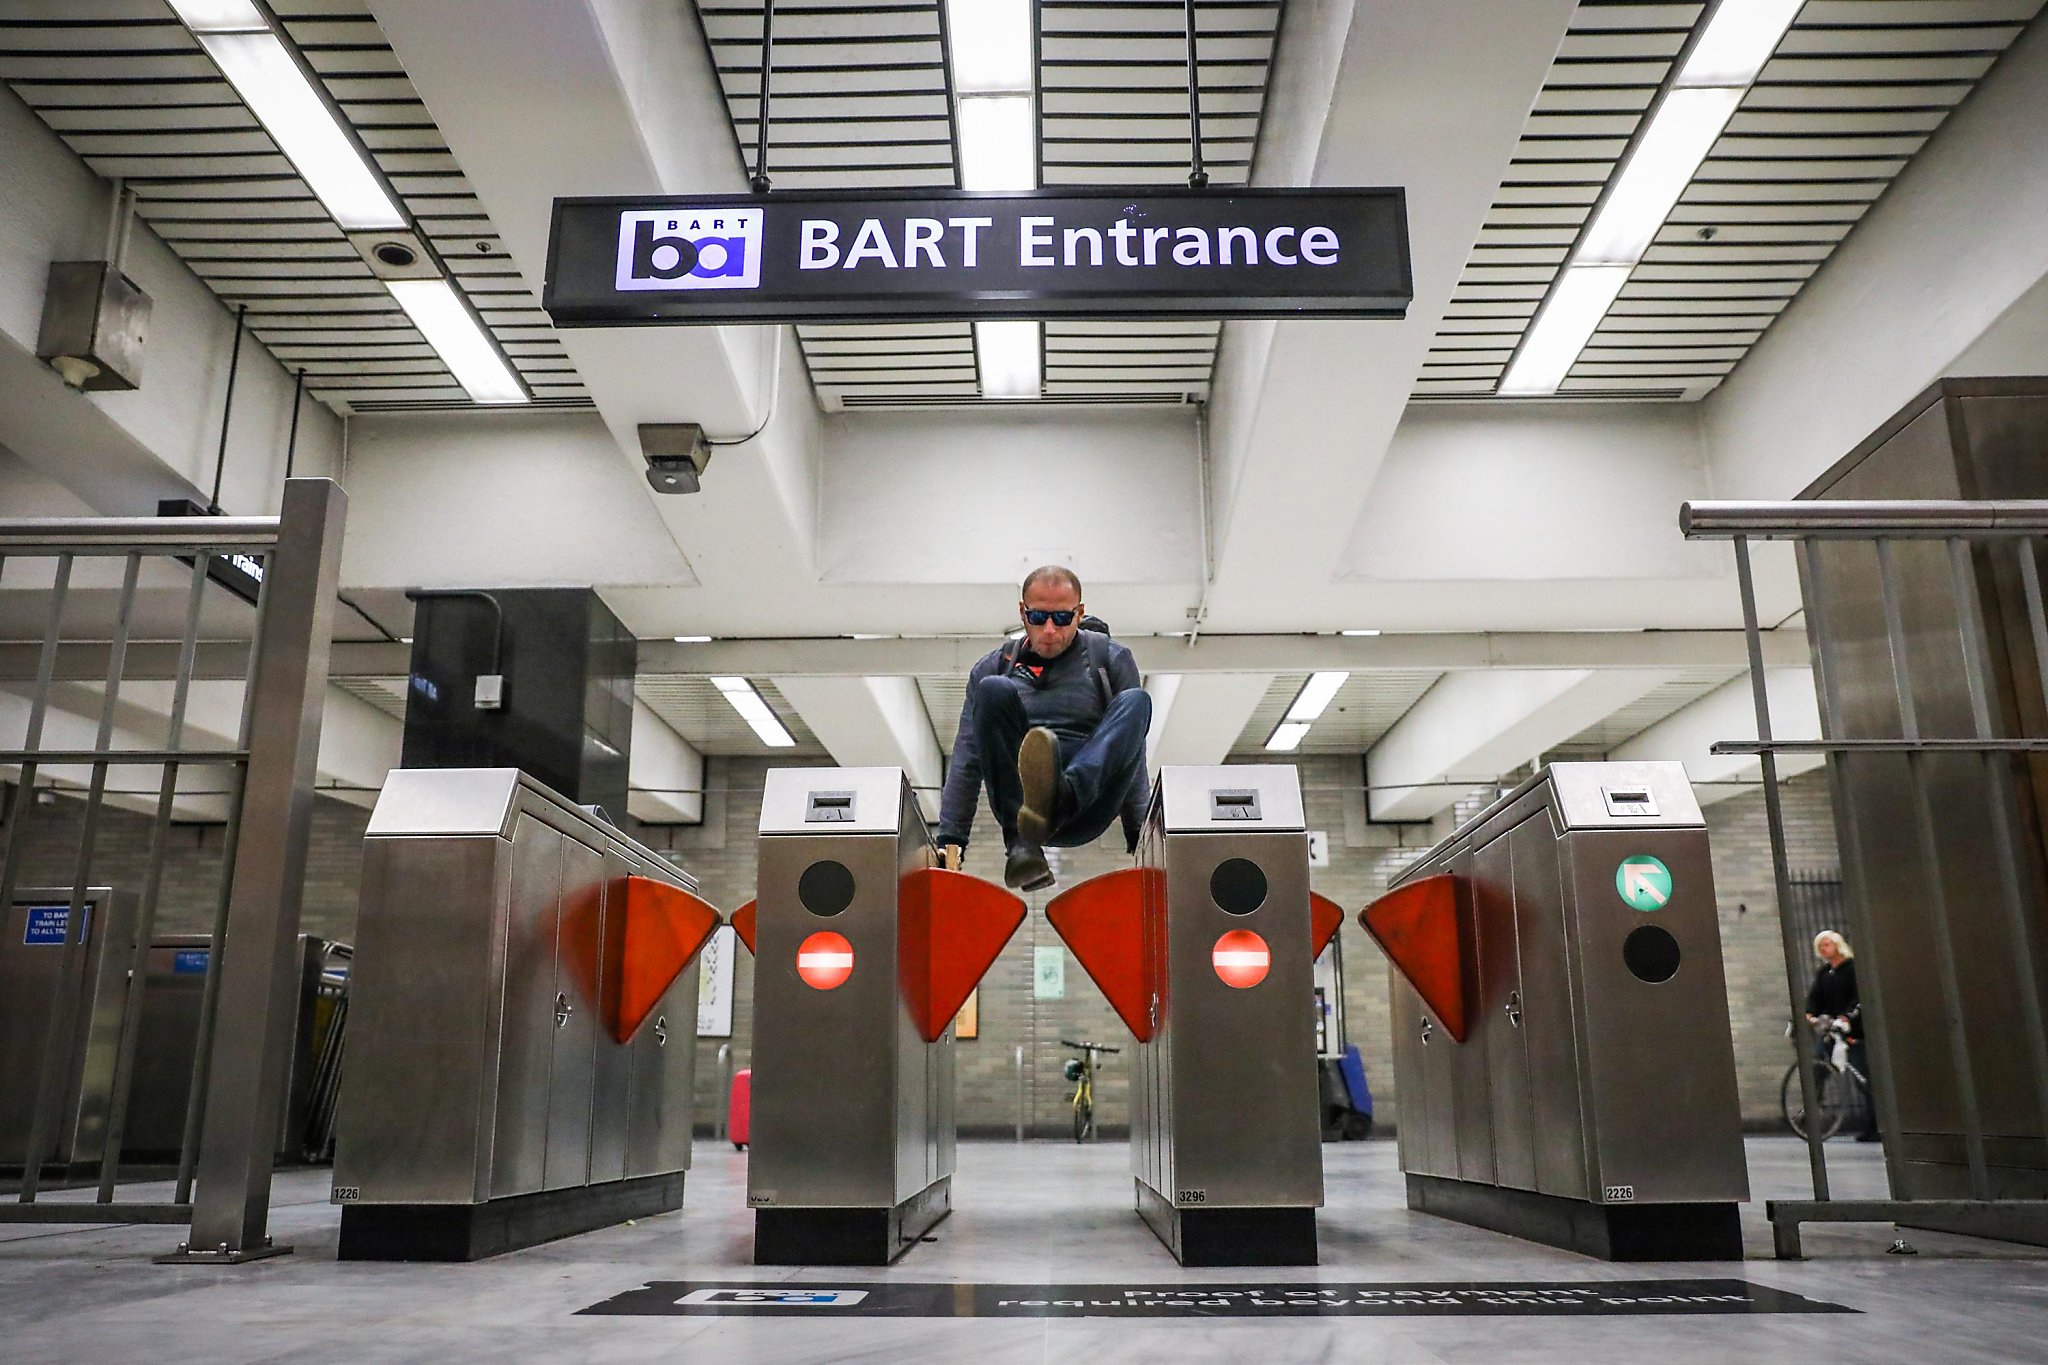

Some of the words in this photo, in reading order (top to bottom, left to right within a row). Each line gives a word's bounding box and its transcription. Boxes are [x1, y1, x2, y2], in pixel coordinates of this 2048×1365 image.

[667, 218, 748, 230] BART
[799, 217, 994, 271] BART
[1018, 214, 1342, 267] Entrance
[334, 1188, 358, 1199] 1226
[1179, 1190, 1205, 1202] 3296
[1607, 1187, 1633, 1199] 2226
[1124, 1290, 1265, 1298] Proof
[1284, 1289, 1338, 1297] of
[1358, 1289, 1600, 1297] payment
[997, 1298, 1232, 1307] required
[1250, 1297, 1463, 1306] beyond
[1477, 1296, 1584, 1305] this
[1599, 1295, 1755, 1305] point
